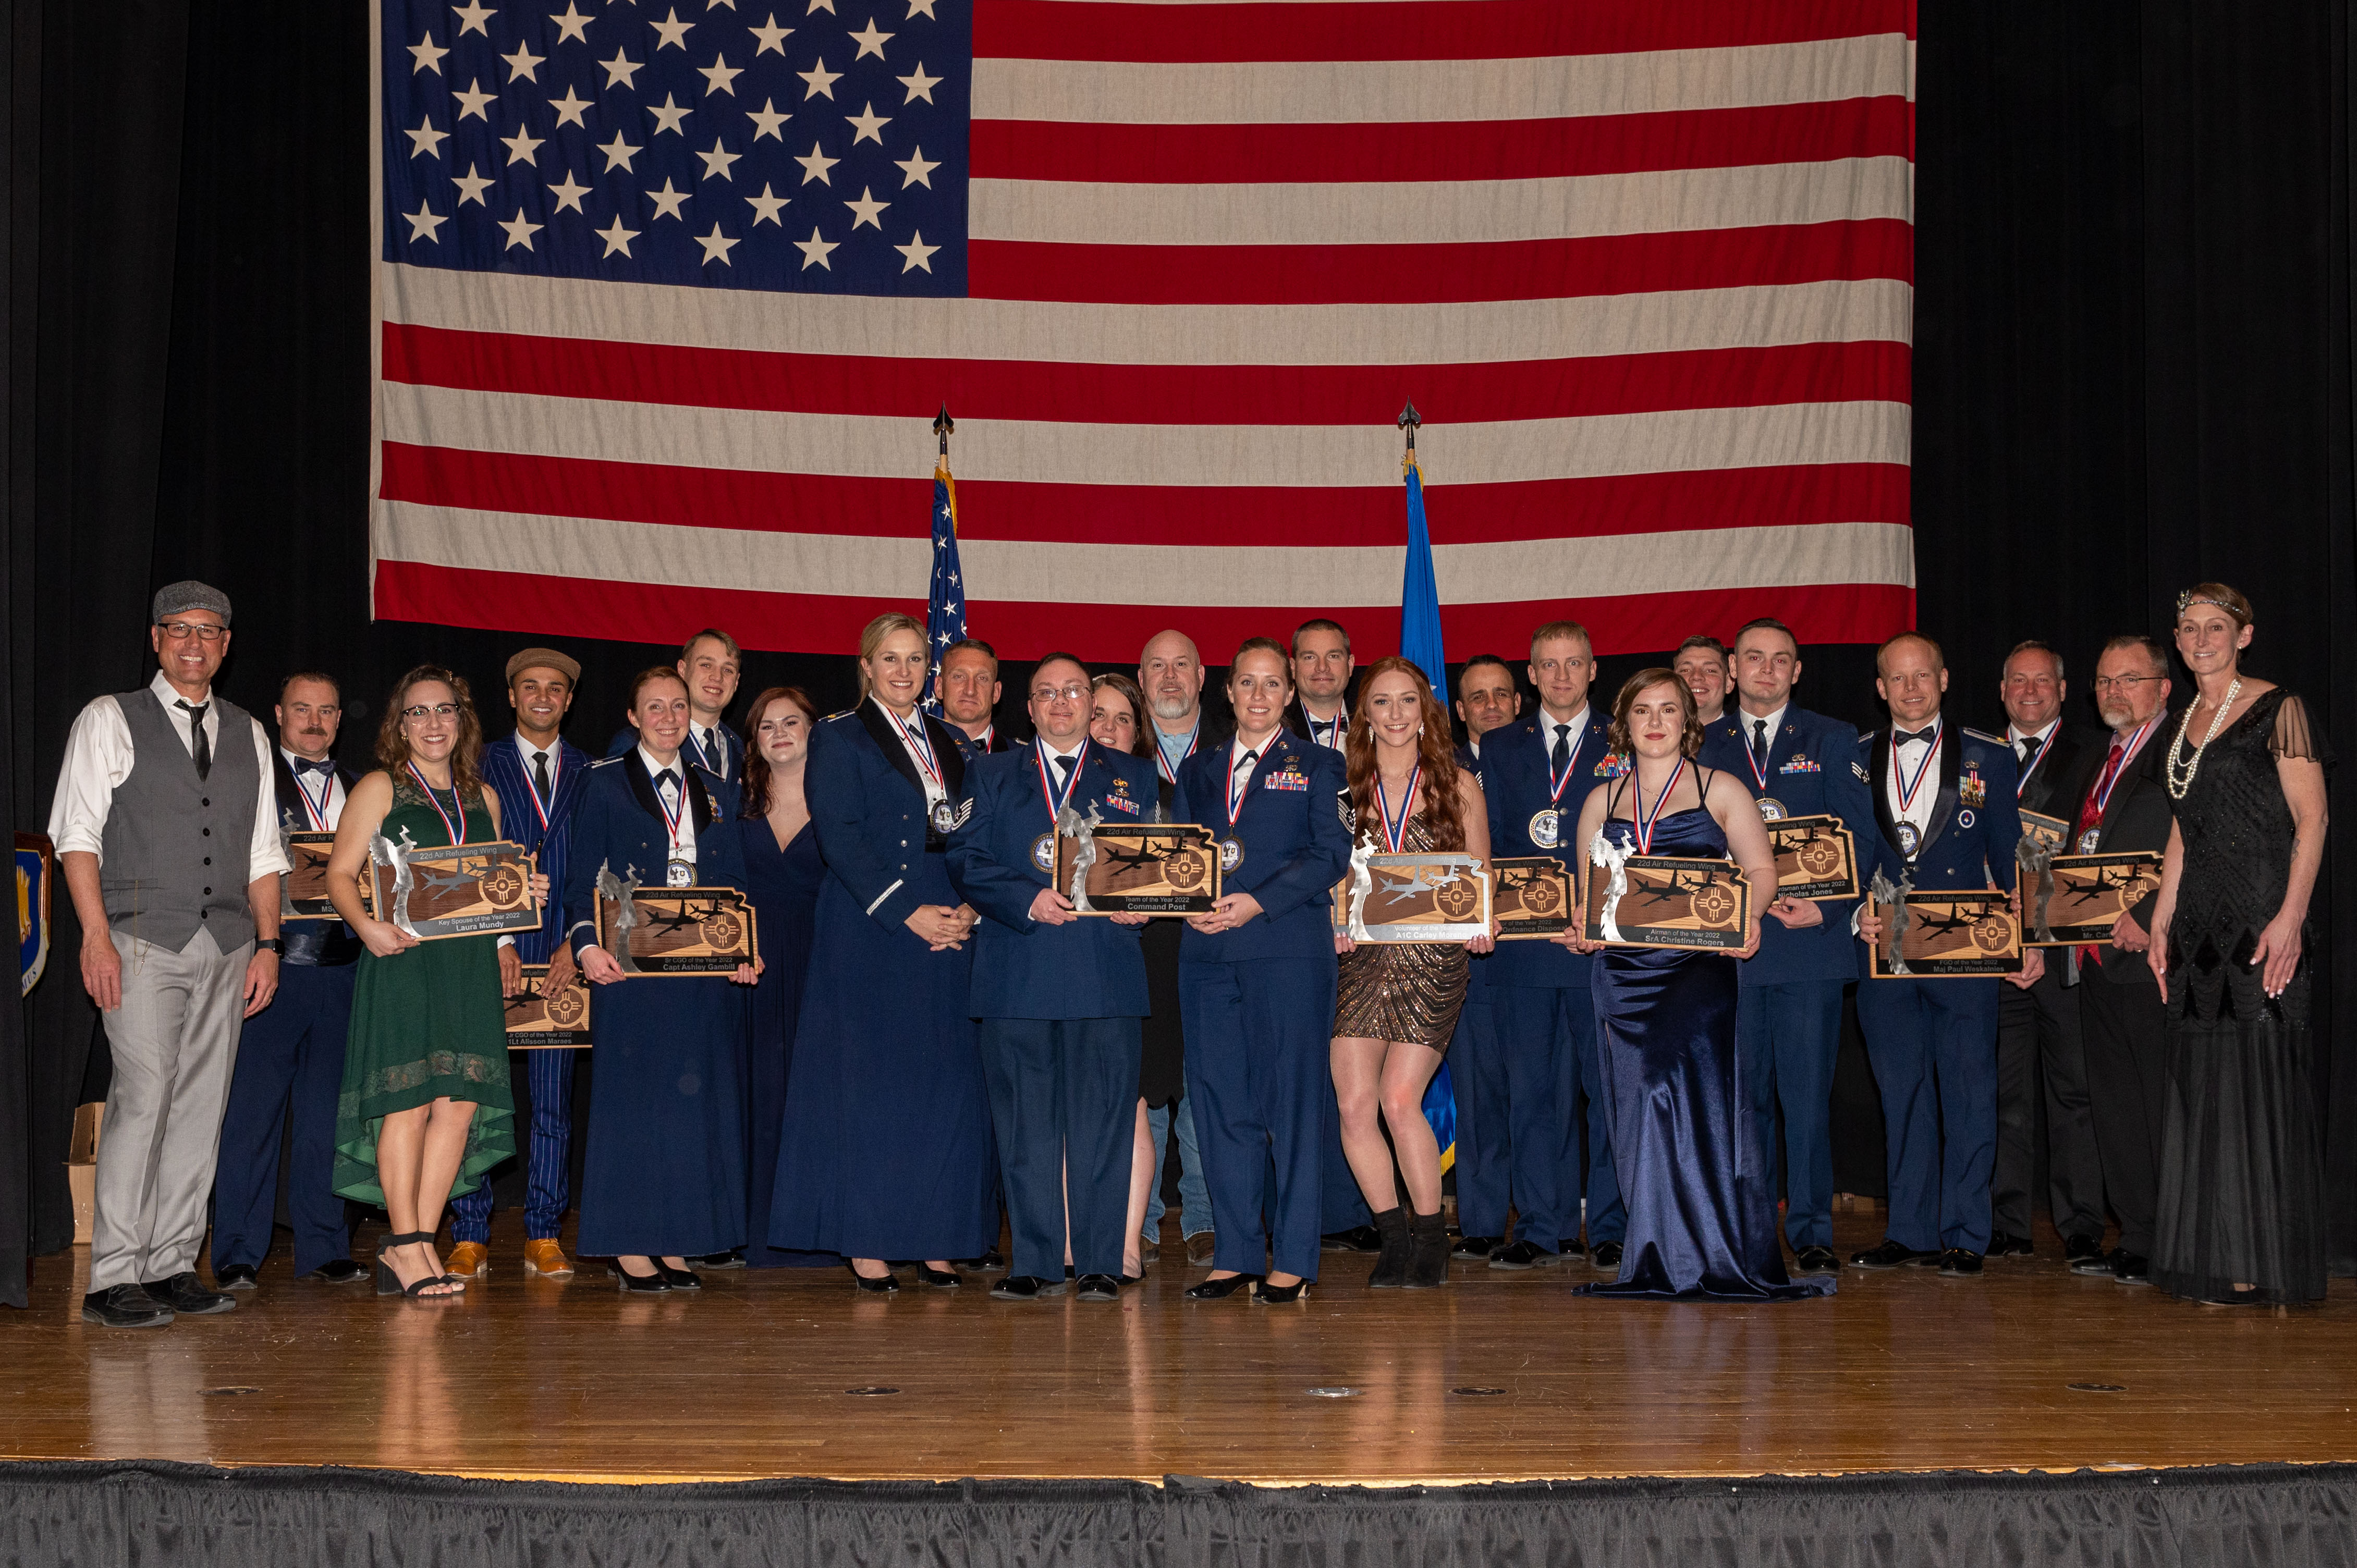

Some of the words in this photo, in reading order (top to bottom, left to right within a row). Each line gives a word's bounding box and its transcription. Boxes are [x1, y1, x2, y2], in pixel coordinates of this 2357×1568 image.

[446, 849, 478, 857] Refueling
[1664, 861, 1696, 869] Refueling
[1697, 863, 1716, 871] Wing
